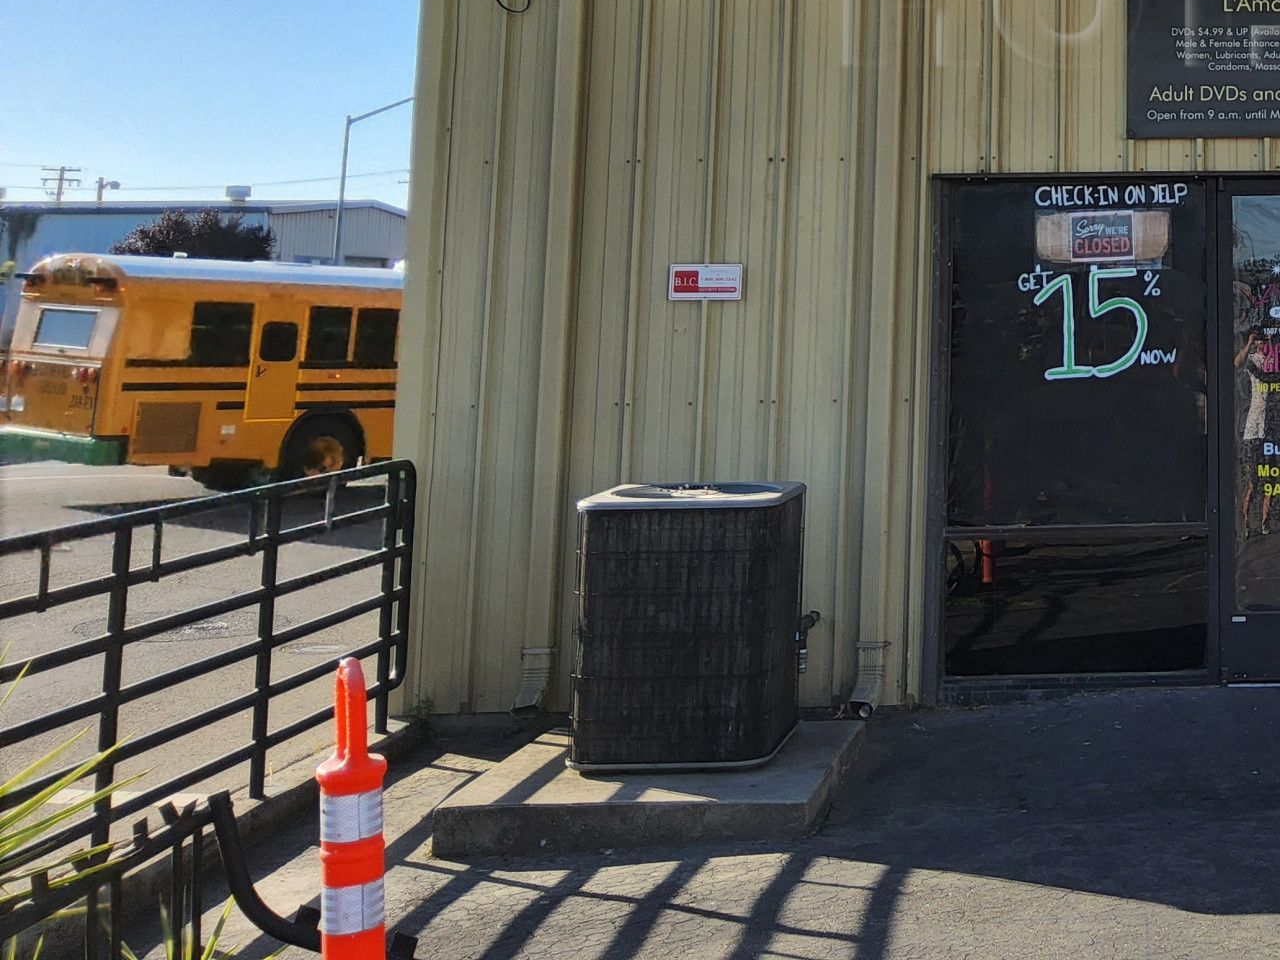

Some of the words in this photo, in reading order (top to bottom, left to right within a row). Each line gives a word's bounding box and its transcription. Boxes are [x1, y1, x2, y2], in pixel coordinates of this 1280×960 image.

[1171, 27, 1196, 36] DVDs
[1198, 27, 1224, 36] $4.99
[1226, 27, 1234, 36] &
[1236, 27, 1249, 36] UP
[1175, 39, 1198, 48] Male
[1200, 39, 1207, 48] &
[1209, 39, 1241, 48] Female
[1176, 51, 1213, 60] Women,
[1215, 50, 1261, 60] Lubricants,
[1208, 62, 1253, 72] Condoms,
[1149, 84, 1194, 102] Adult
[1199, 85, 1247, 102] DVDs
[1146, 109, 1177, 123] Open
[1180, 108, 1204, 120] from
[1207, 109, 1214, 120] 9
[1218, 111, 1242, 120] a.m.
[1245, 108, 1267, 120] until
[1034, 184, 1119, 207] CHECK-IN
[1124, 184, 1146, 205] ON
[1075, 219, 1105, 238] Sorry
[1105, 225, 1129, 236] WE'RE
[1074, 236, 1131, 254] CLOSED
[1017, 268, 1054, 291] GET
[1140, 347, 1177, 365] NOW
